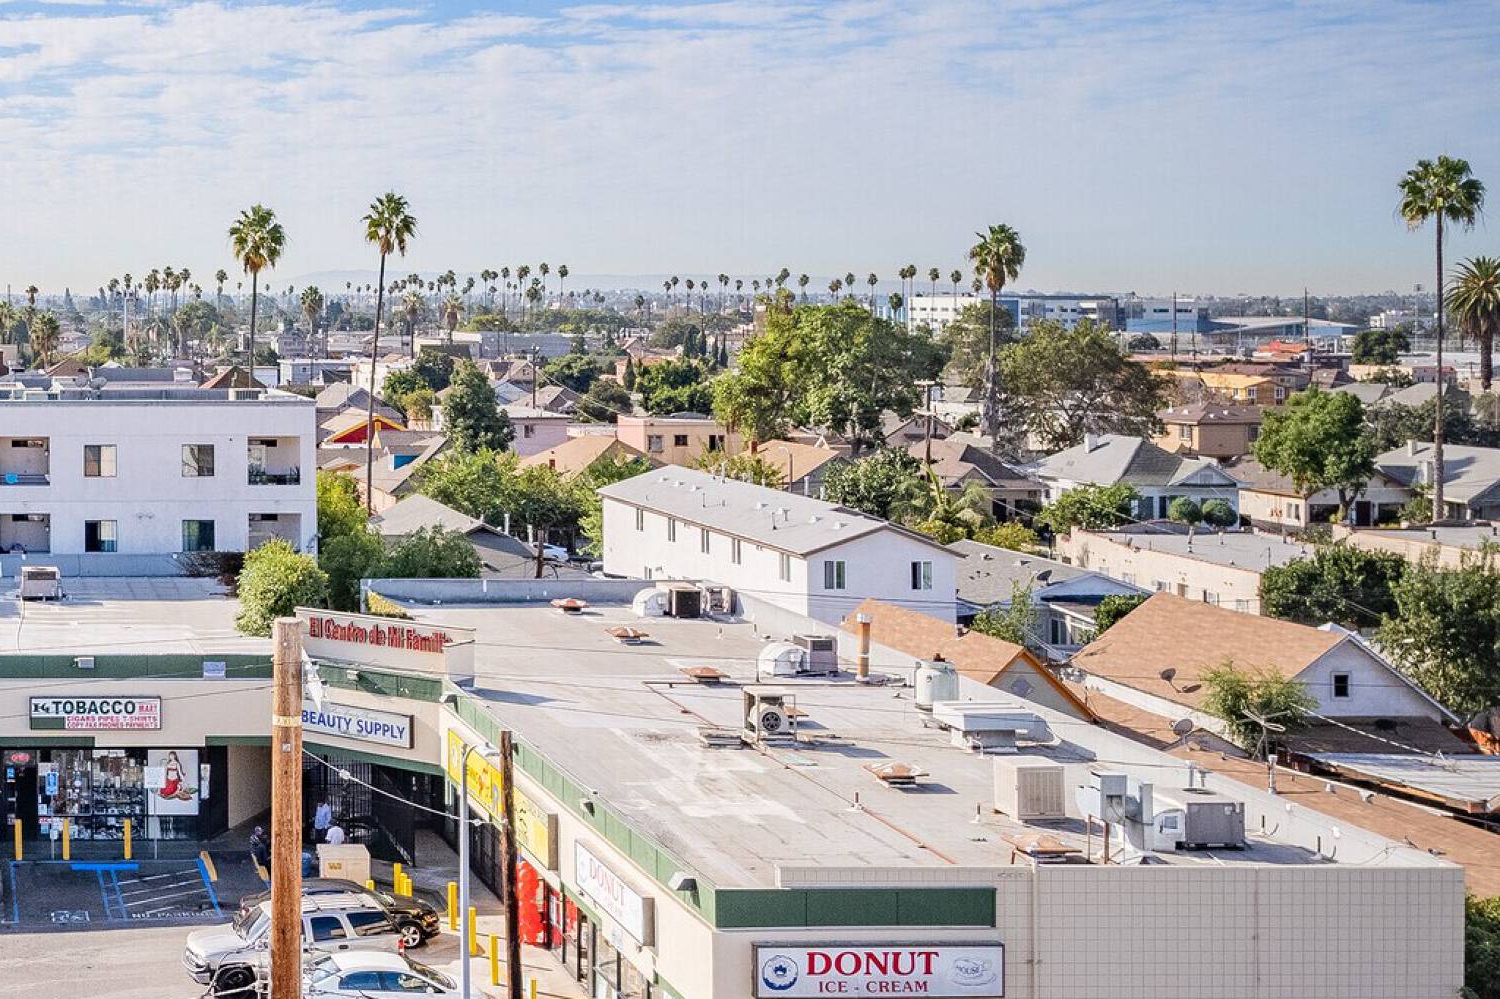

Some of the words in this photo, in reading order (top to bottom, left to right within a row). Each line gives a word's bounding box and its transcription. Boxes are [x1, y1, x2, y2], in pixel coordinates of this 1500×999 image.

[309, 617, 323, 638] El
[325, 618, 367, 643] Centro
[369, 624, 386, 647] de
[388, 626, 405, 648] Mi
[51, 701, 136, 714] TOBACCO
[302, 710, 353, 731] BEAUTY
[356, 720, 405, 739] SUPPLY
[589, 857, 625, 907] DONUT
[806, 951, 939, 976] DONUT
[819, 980, 848, 993] ICE
[866, 980, 929, 993] CREAM
